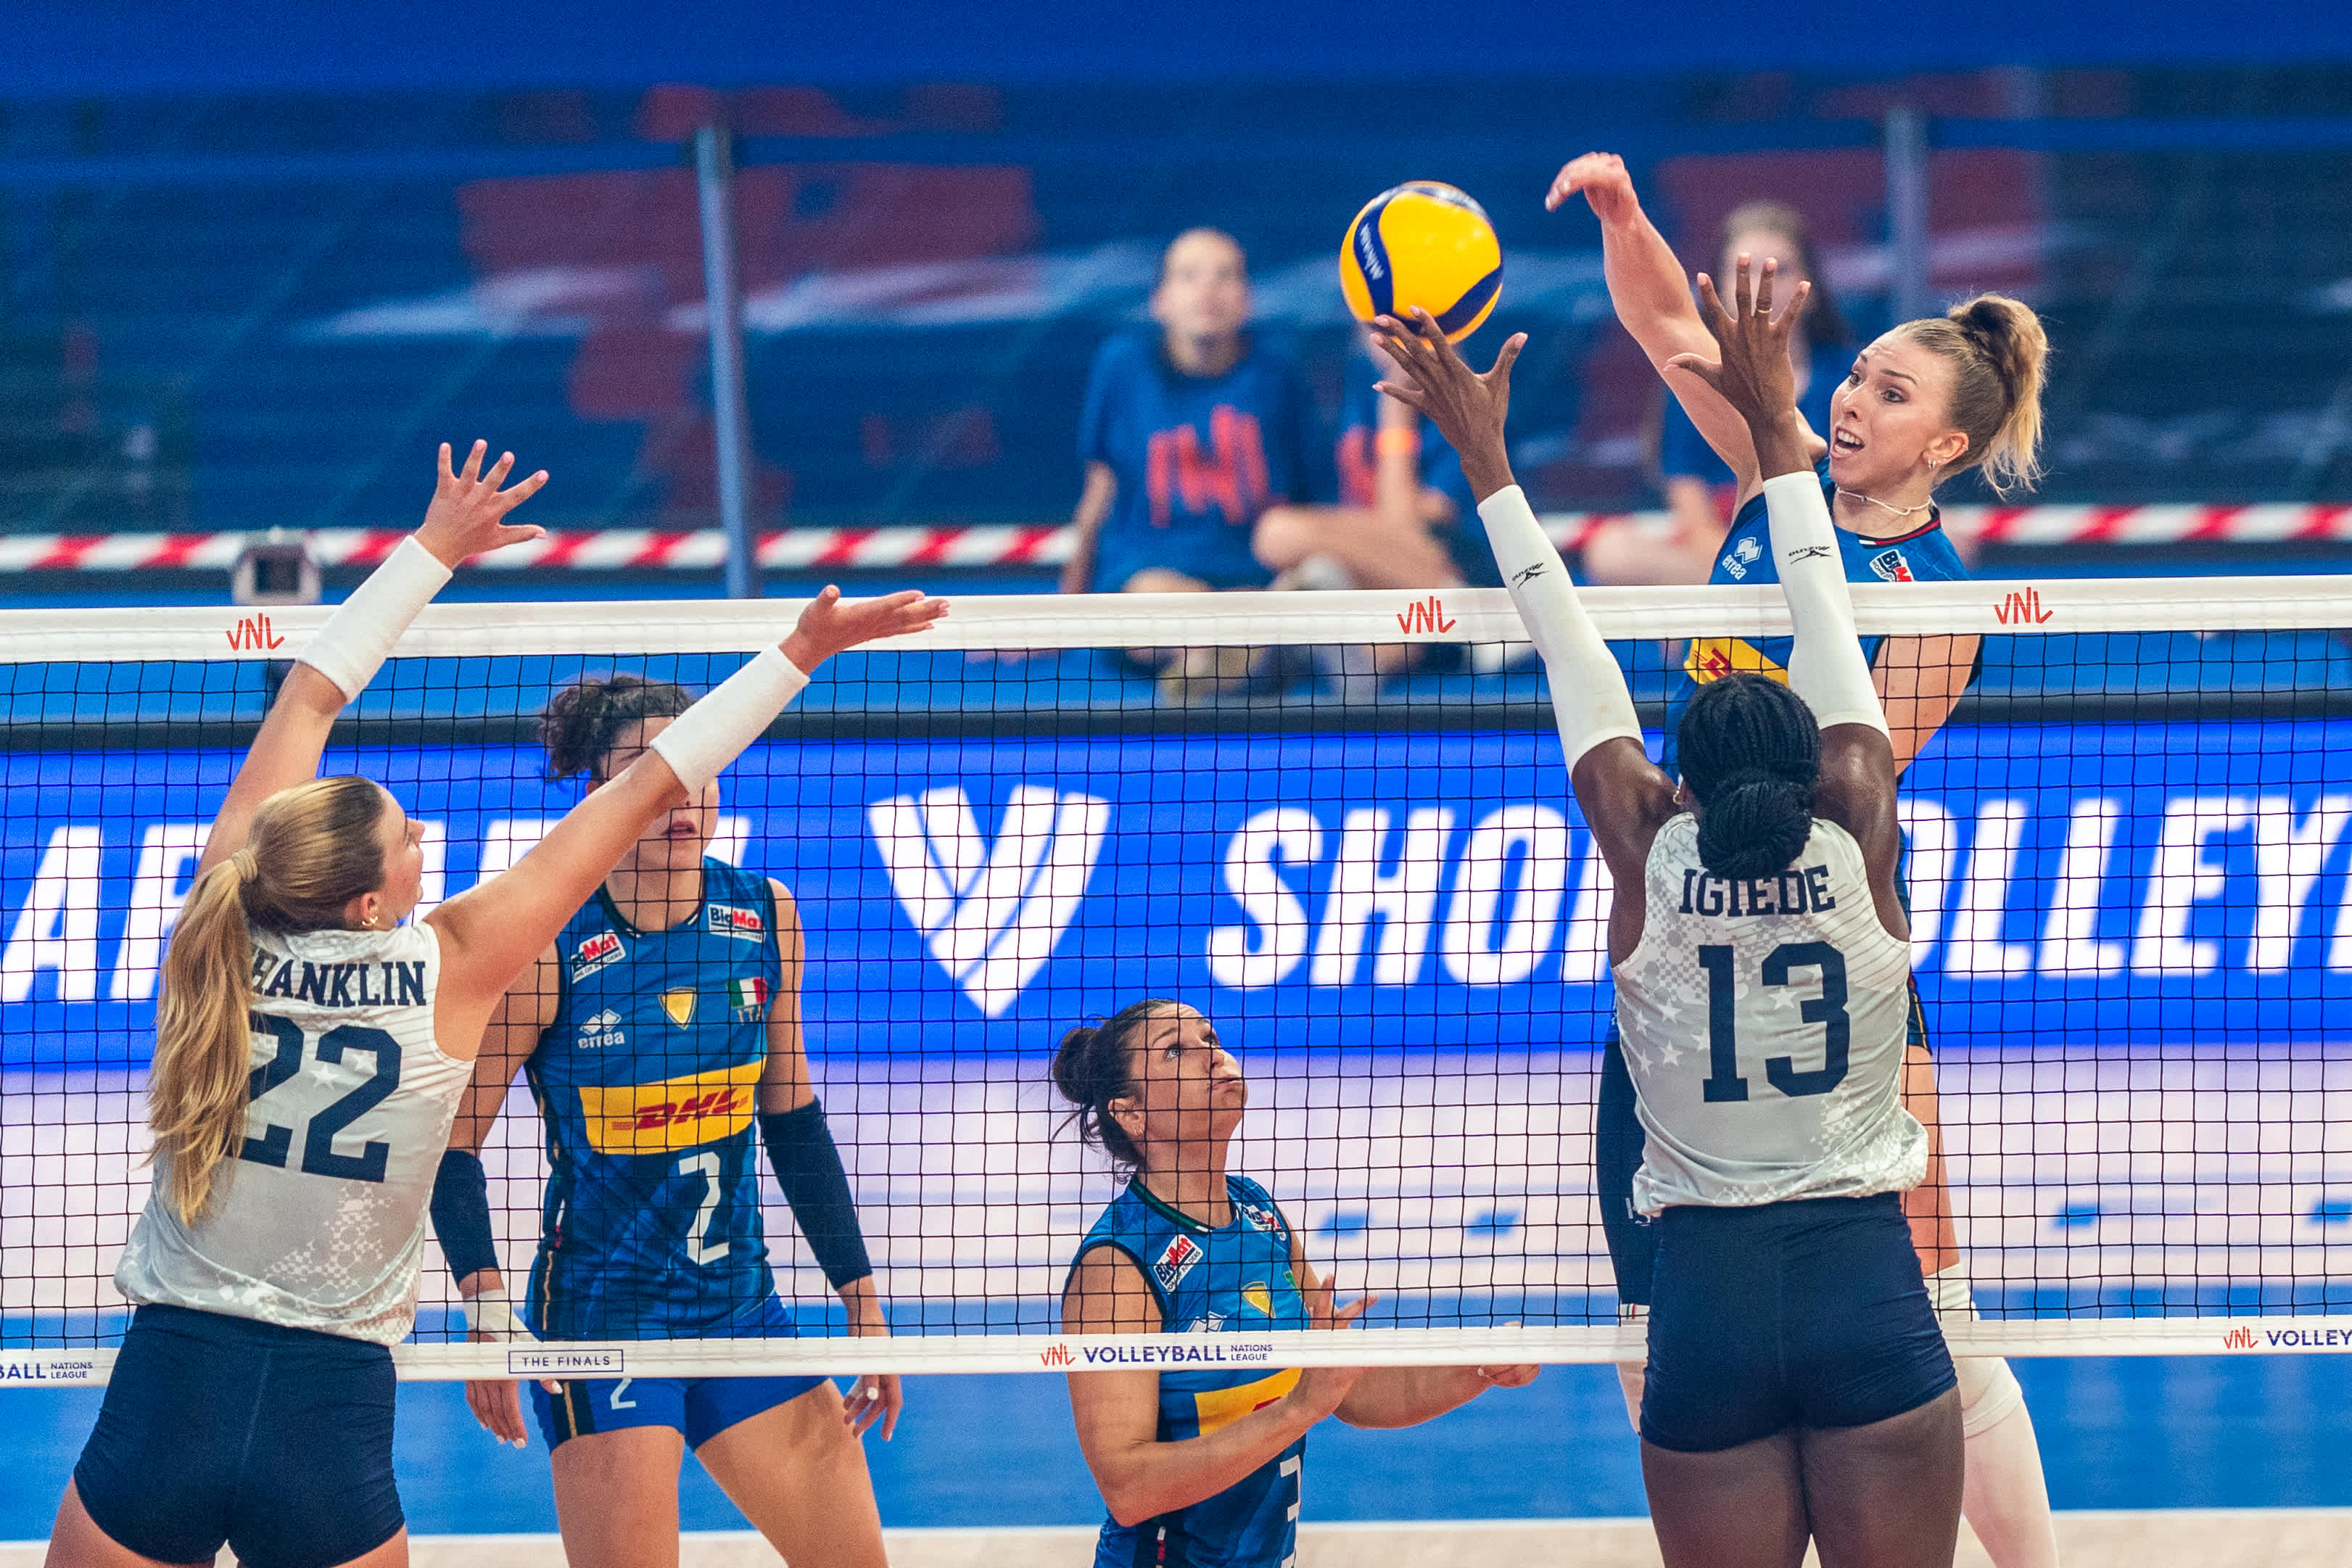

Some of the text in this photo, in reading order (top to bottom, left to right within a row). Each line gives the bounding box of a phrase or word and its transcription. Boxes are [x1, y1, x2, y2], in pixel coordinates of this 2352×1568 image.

[1397, 595, 1456, 634] VNL
[1994, 586, 2054, 624] VNL
[226, 613, 285, 651] VNL
[1678, 864, 1836, 917] IGIEDE
[252, 949, 427, 1007] RANKLIN
[1698, 940, 1850, 1102] 13
[241, 1010, 402, 1183] 22
[635, 1088, 739, 1131] DHL
[678, 1151, 730, 1266] 2
[1040, 1342, 1227, 1366] VNL VOLLEYBALL
[1231, 1344, 1273, 1353] NATIONS
[2223, 1326, 2258, 1349] VNL
[51, 1371, 88, 1379] LEAGUE
[522, 1356, 611, 1366] THE FINALS
